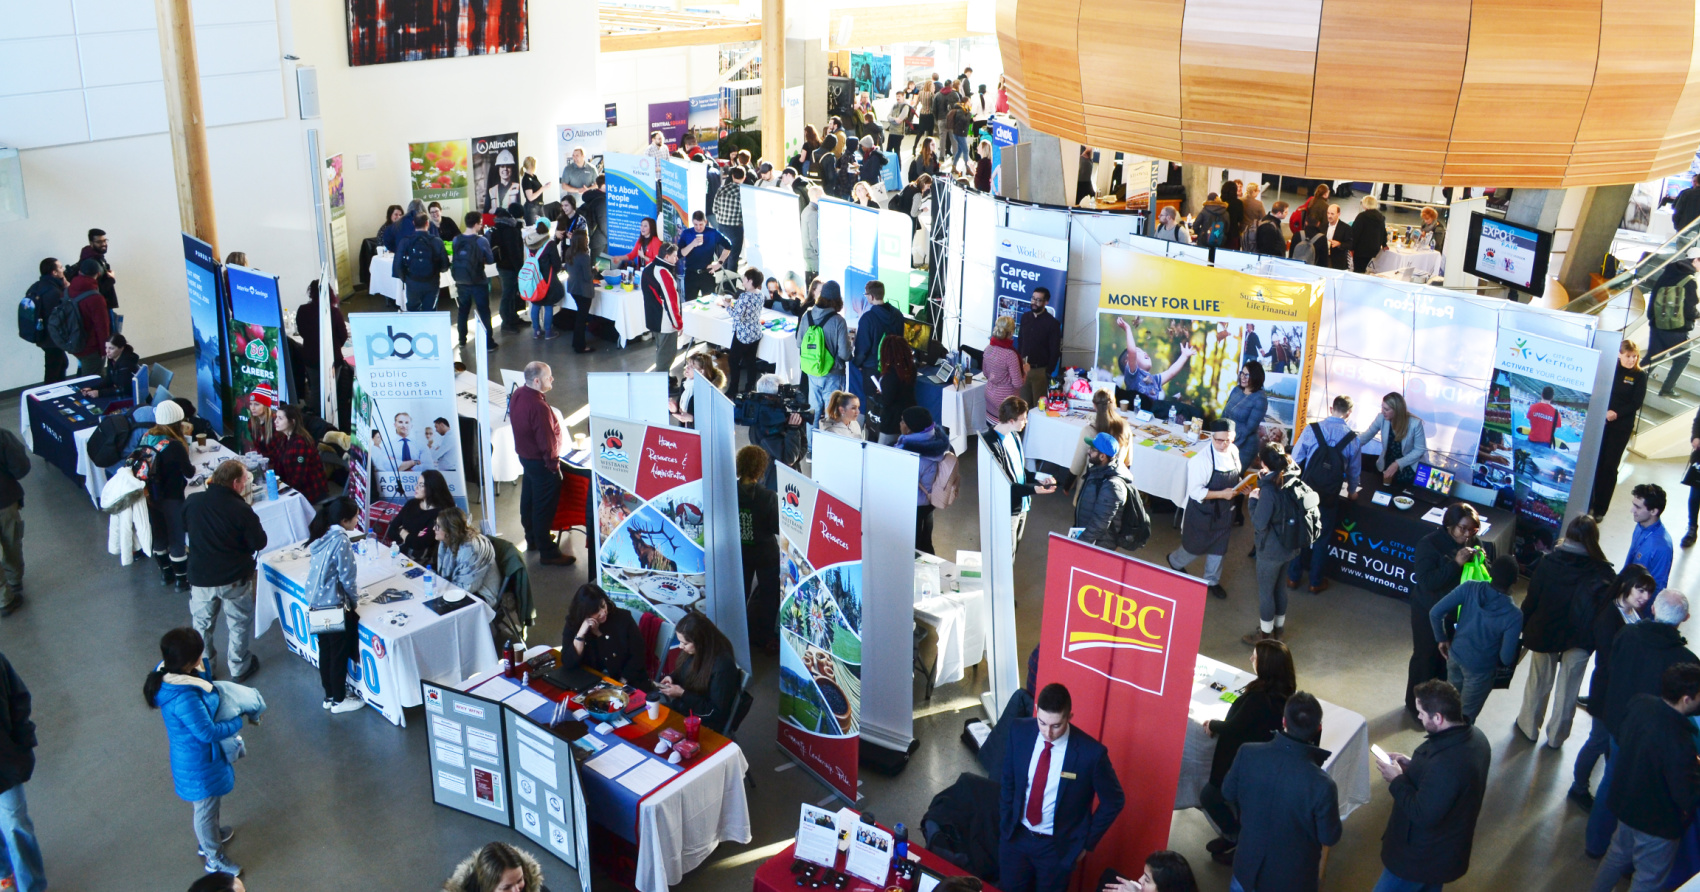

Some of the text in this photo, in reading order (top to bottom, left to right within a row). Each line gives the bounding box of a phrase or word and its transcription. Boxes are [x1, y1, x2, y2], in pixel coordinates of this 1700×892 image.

[574, 128, 603, 138] Allnorth
[488, 139, 516, 149] Allnorth
[1150, 164, 1159, 198] JOIN
[428, 192, 440, 200] way
[441, 190, 449, 198] of
[449, 190, 460, 198] life
[607, 184, 639, 195] It's About
[607, 193, 630, 203] People
[1482, 225, 1507, 240] EXPO
[1500, 241, 1518, 251] FAIR
[1016, 245, 1062, 264] WorkBC.ca
[1000, 262, 1041, 282] Career
[236, 284, 269, 298] Interior Savings
[999, 276, 1027, 294] Trek
[1108, 293, 1158, 308] MONEY
[1161, 296, 1190, 310] FOR
[1246, 301, 1298, 318] Life Financial
[250, 343, 264, 357] BC
[365, 325, 440, 366] pba
[1535, 353, 1583, 373] Vernon
[241, 365, 275, 380] CAREERS
[370, 369, 408, 380] public
[1501, 360, 1585, 388] ACTIVATE YOUR CAREER
[371, 380, 427, 388] business
[372, 389, 443, 397] accountant
[658, 435, 678, 450] Human
[600, 460, 629, 469] WESTBANK
[646, 447, 688, 470] Resources &
[379, 476, 387, 484] A
[650, 463, 687, 482] Administration
[826, 504, 845, 528] Human
[819, 520, 849, 550] Resources
[1389, 540, 1416, 553] CITY OF
[1362, 555, 1405, 580] YOUR
[1340, 565, 1409, 594] www.vernon.ca
[1077, 584, 1165, 640] CIBC
